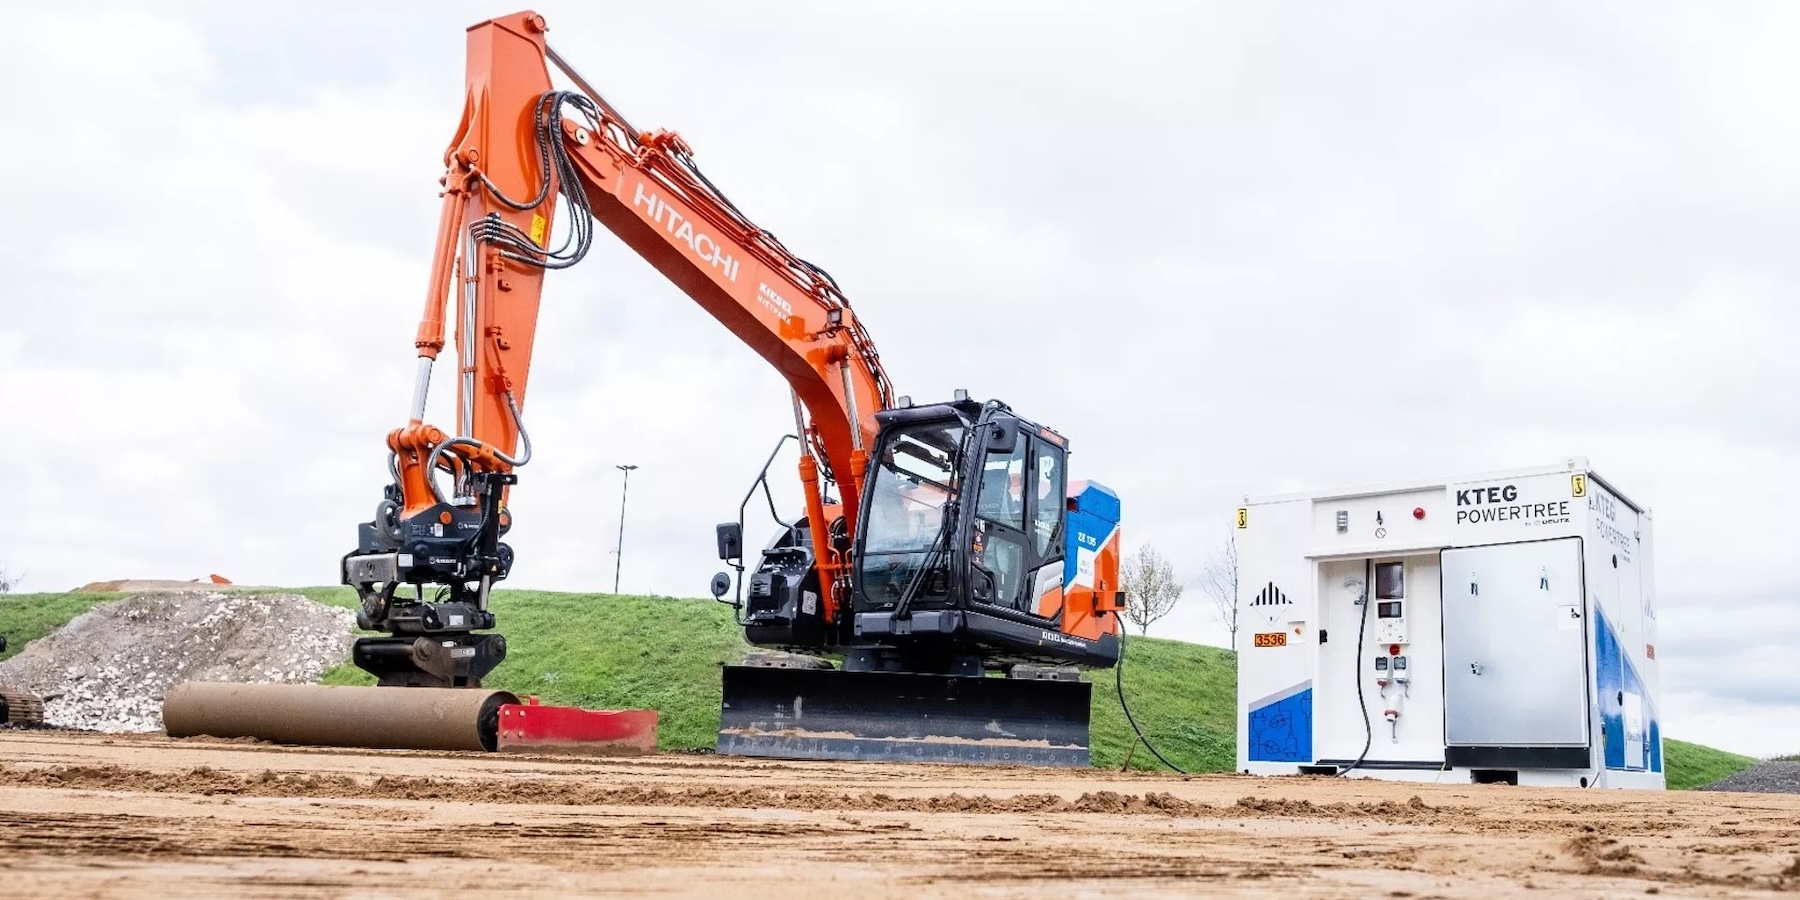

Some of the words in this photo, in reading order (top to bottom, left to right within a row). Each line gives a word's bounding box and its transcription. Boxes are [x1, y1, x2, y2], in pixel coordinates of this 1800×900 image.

[633, 182, 740, 283] HITACHI
[759, 281, 793, 316] KIESEL
[1456, 485, 1518, 506] KTEG
[1595, 490, 1616, 522] KTEG
[1456, 501, 1570, 525] POWERTREE
[1256, 634, 1285, 646] 3536
